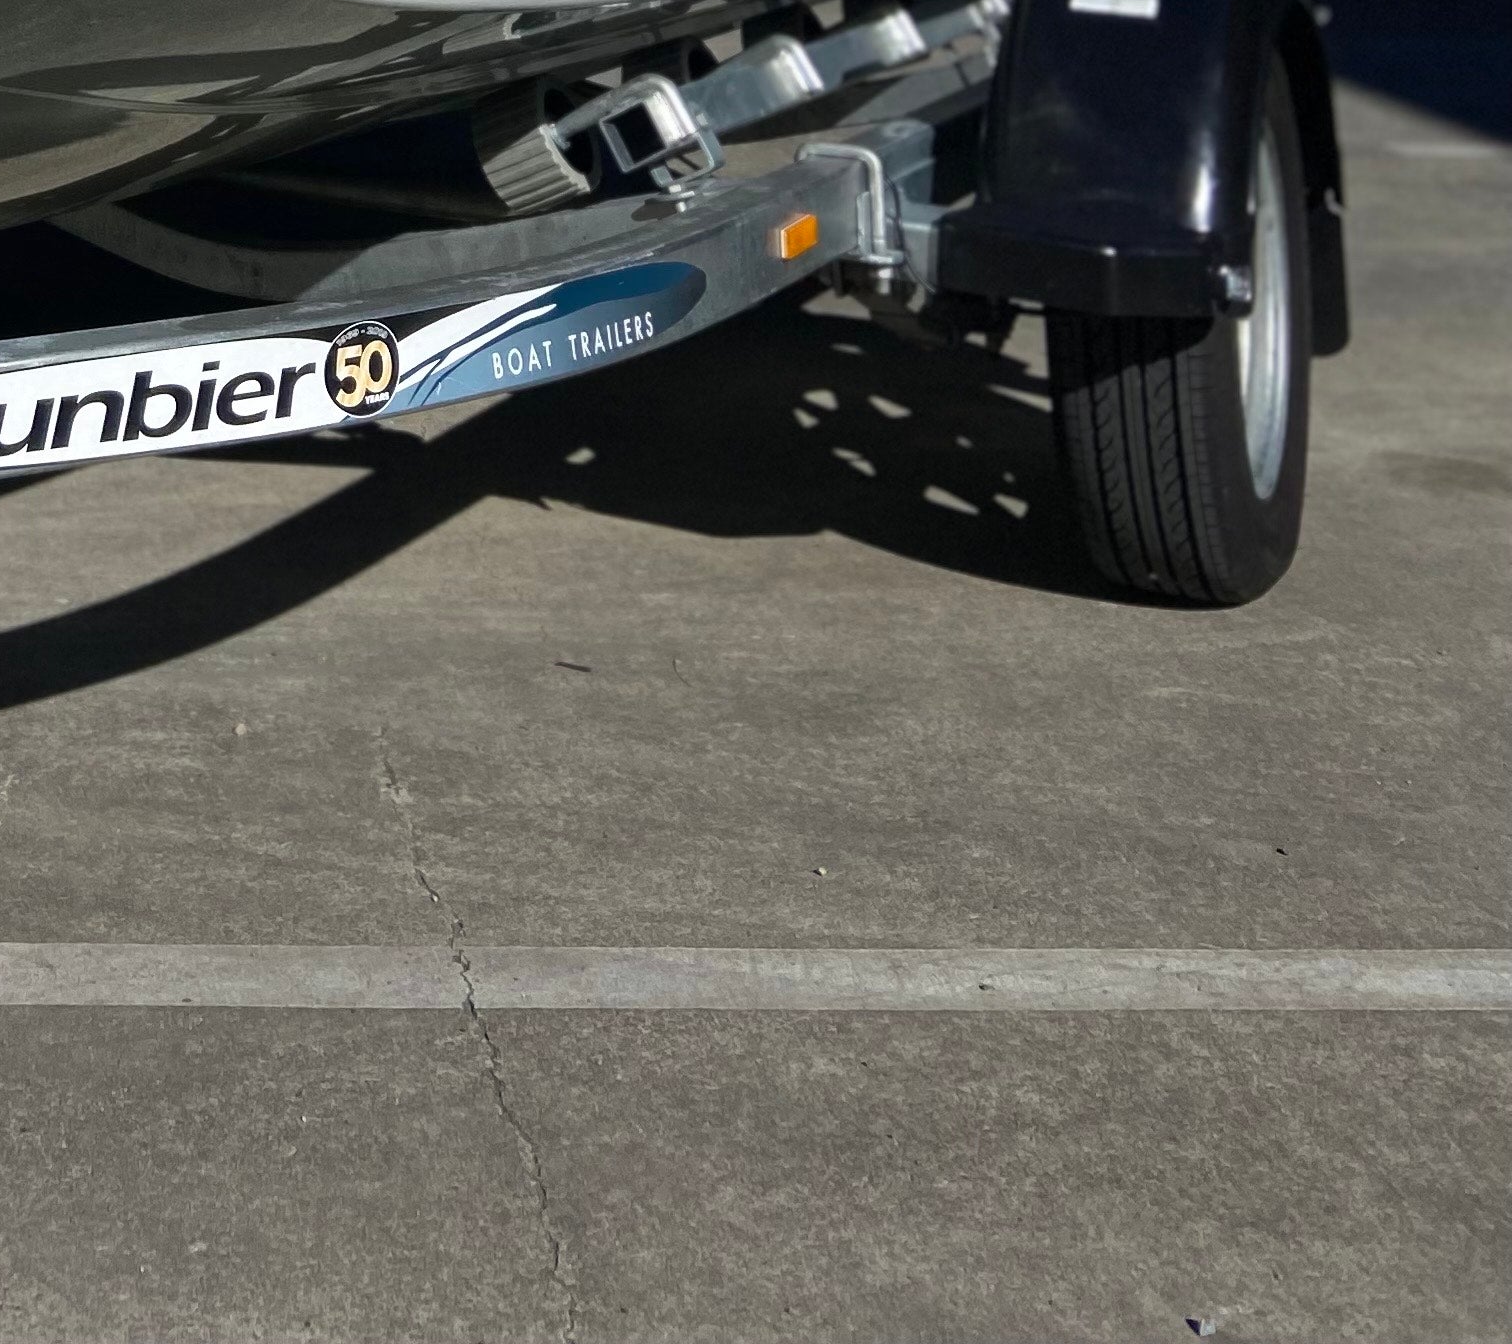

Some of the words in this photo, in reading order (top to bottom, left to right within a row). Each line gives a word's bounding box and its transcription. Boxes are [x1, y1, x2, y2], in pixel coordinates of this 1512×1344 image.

[335, 340, 393, 408] 50
[492, 340, 552, 380] BOAT
[568, 311, 654, 361] TRAILERS
[364, 391, 389, 404] YEARS
